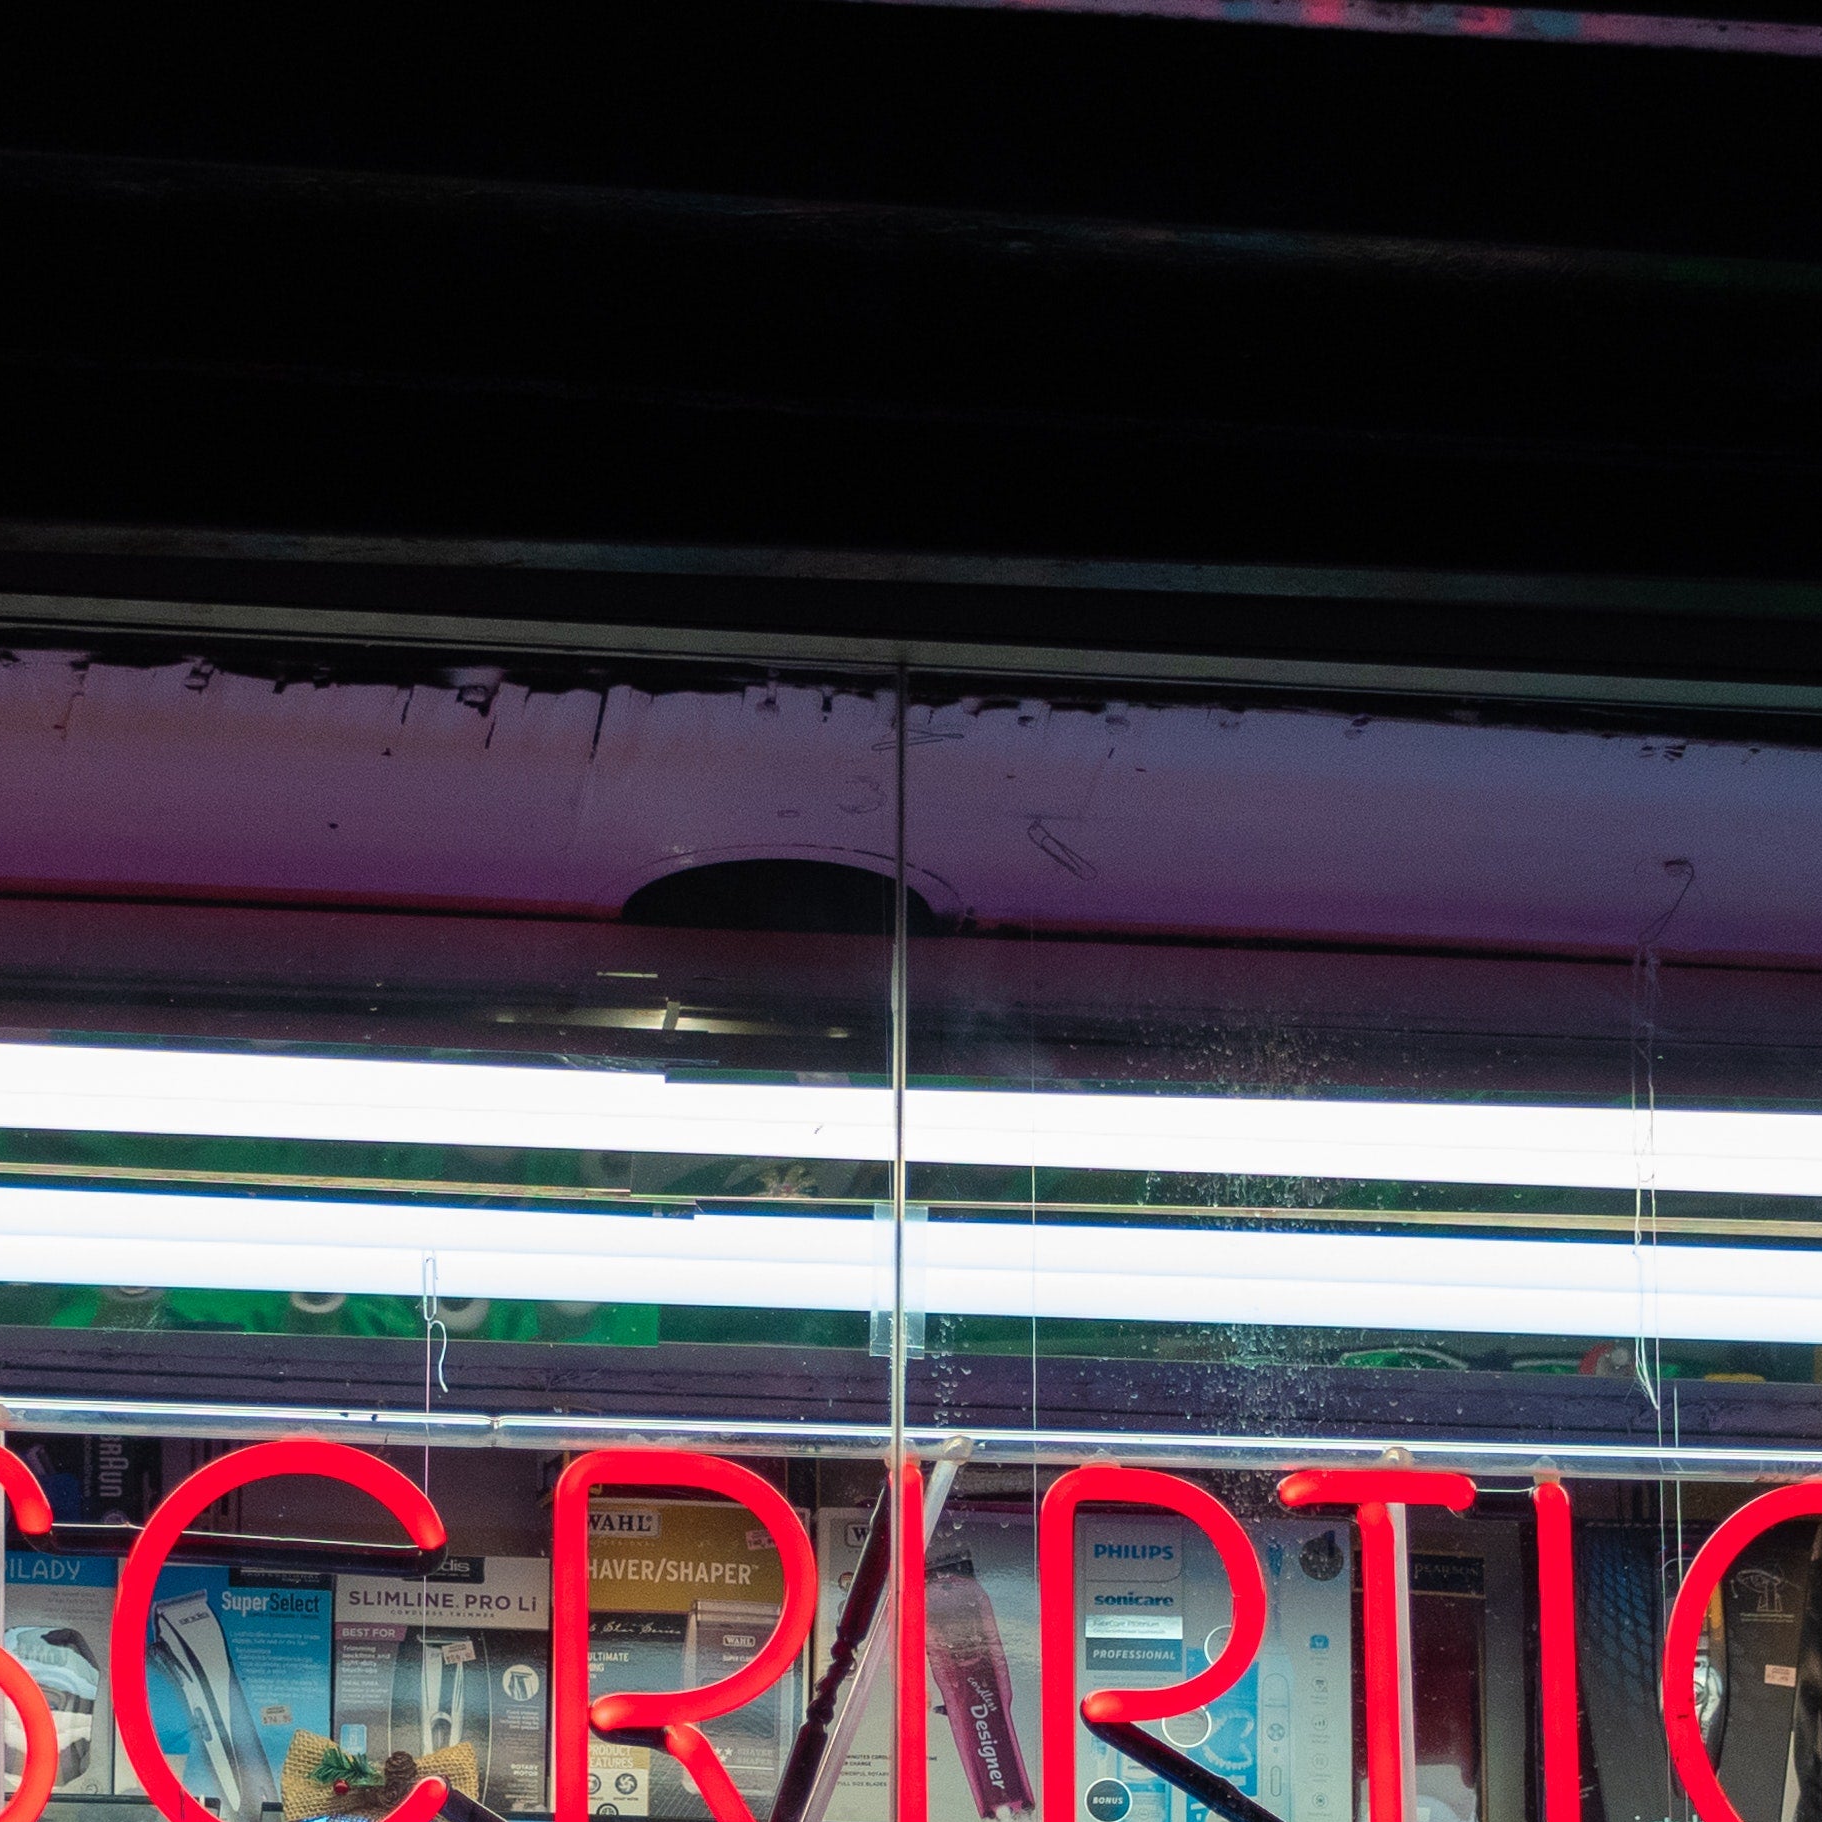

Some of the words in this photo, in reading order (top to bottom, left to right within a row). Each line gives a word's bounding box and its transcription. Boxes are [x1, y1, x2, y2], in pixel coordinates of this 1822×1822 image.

[99, 1437, 129, 1498] BRAUN
[588, 1512, 653, 1533] WAHL
[1094, 1543, 1173, 1560] PHILIPS
[221, 1591, 319, 1618] SuperSelect
[350, 1590, 458, 1608] SLIMLINE
[466, 1593, 510, 1610] PRO
[1094, 1591, 1173, 1606] sonicare
[342, 1628, 369, 1639] BEST
[372, 1629, 395, 1639] FOR
[725, 1637, 754, 1645] WAHL
[1093, 1648, 1175, 1660] PROFESSIONAL
[969, 1705, 1005, 1790] Designer
[1093, 1796, 1123, 1804] BONUS
